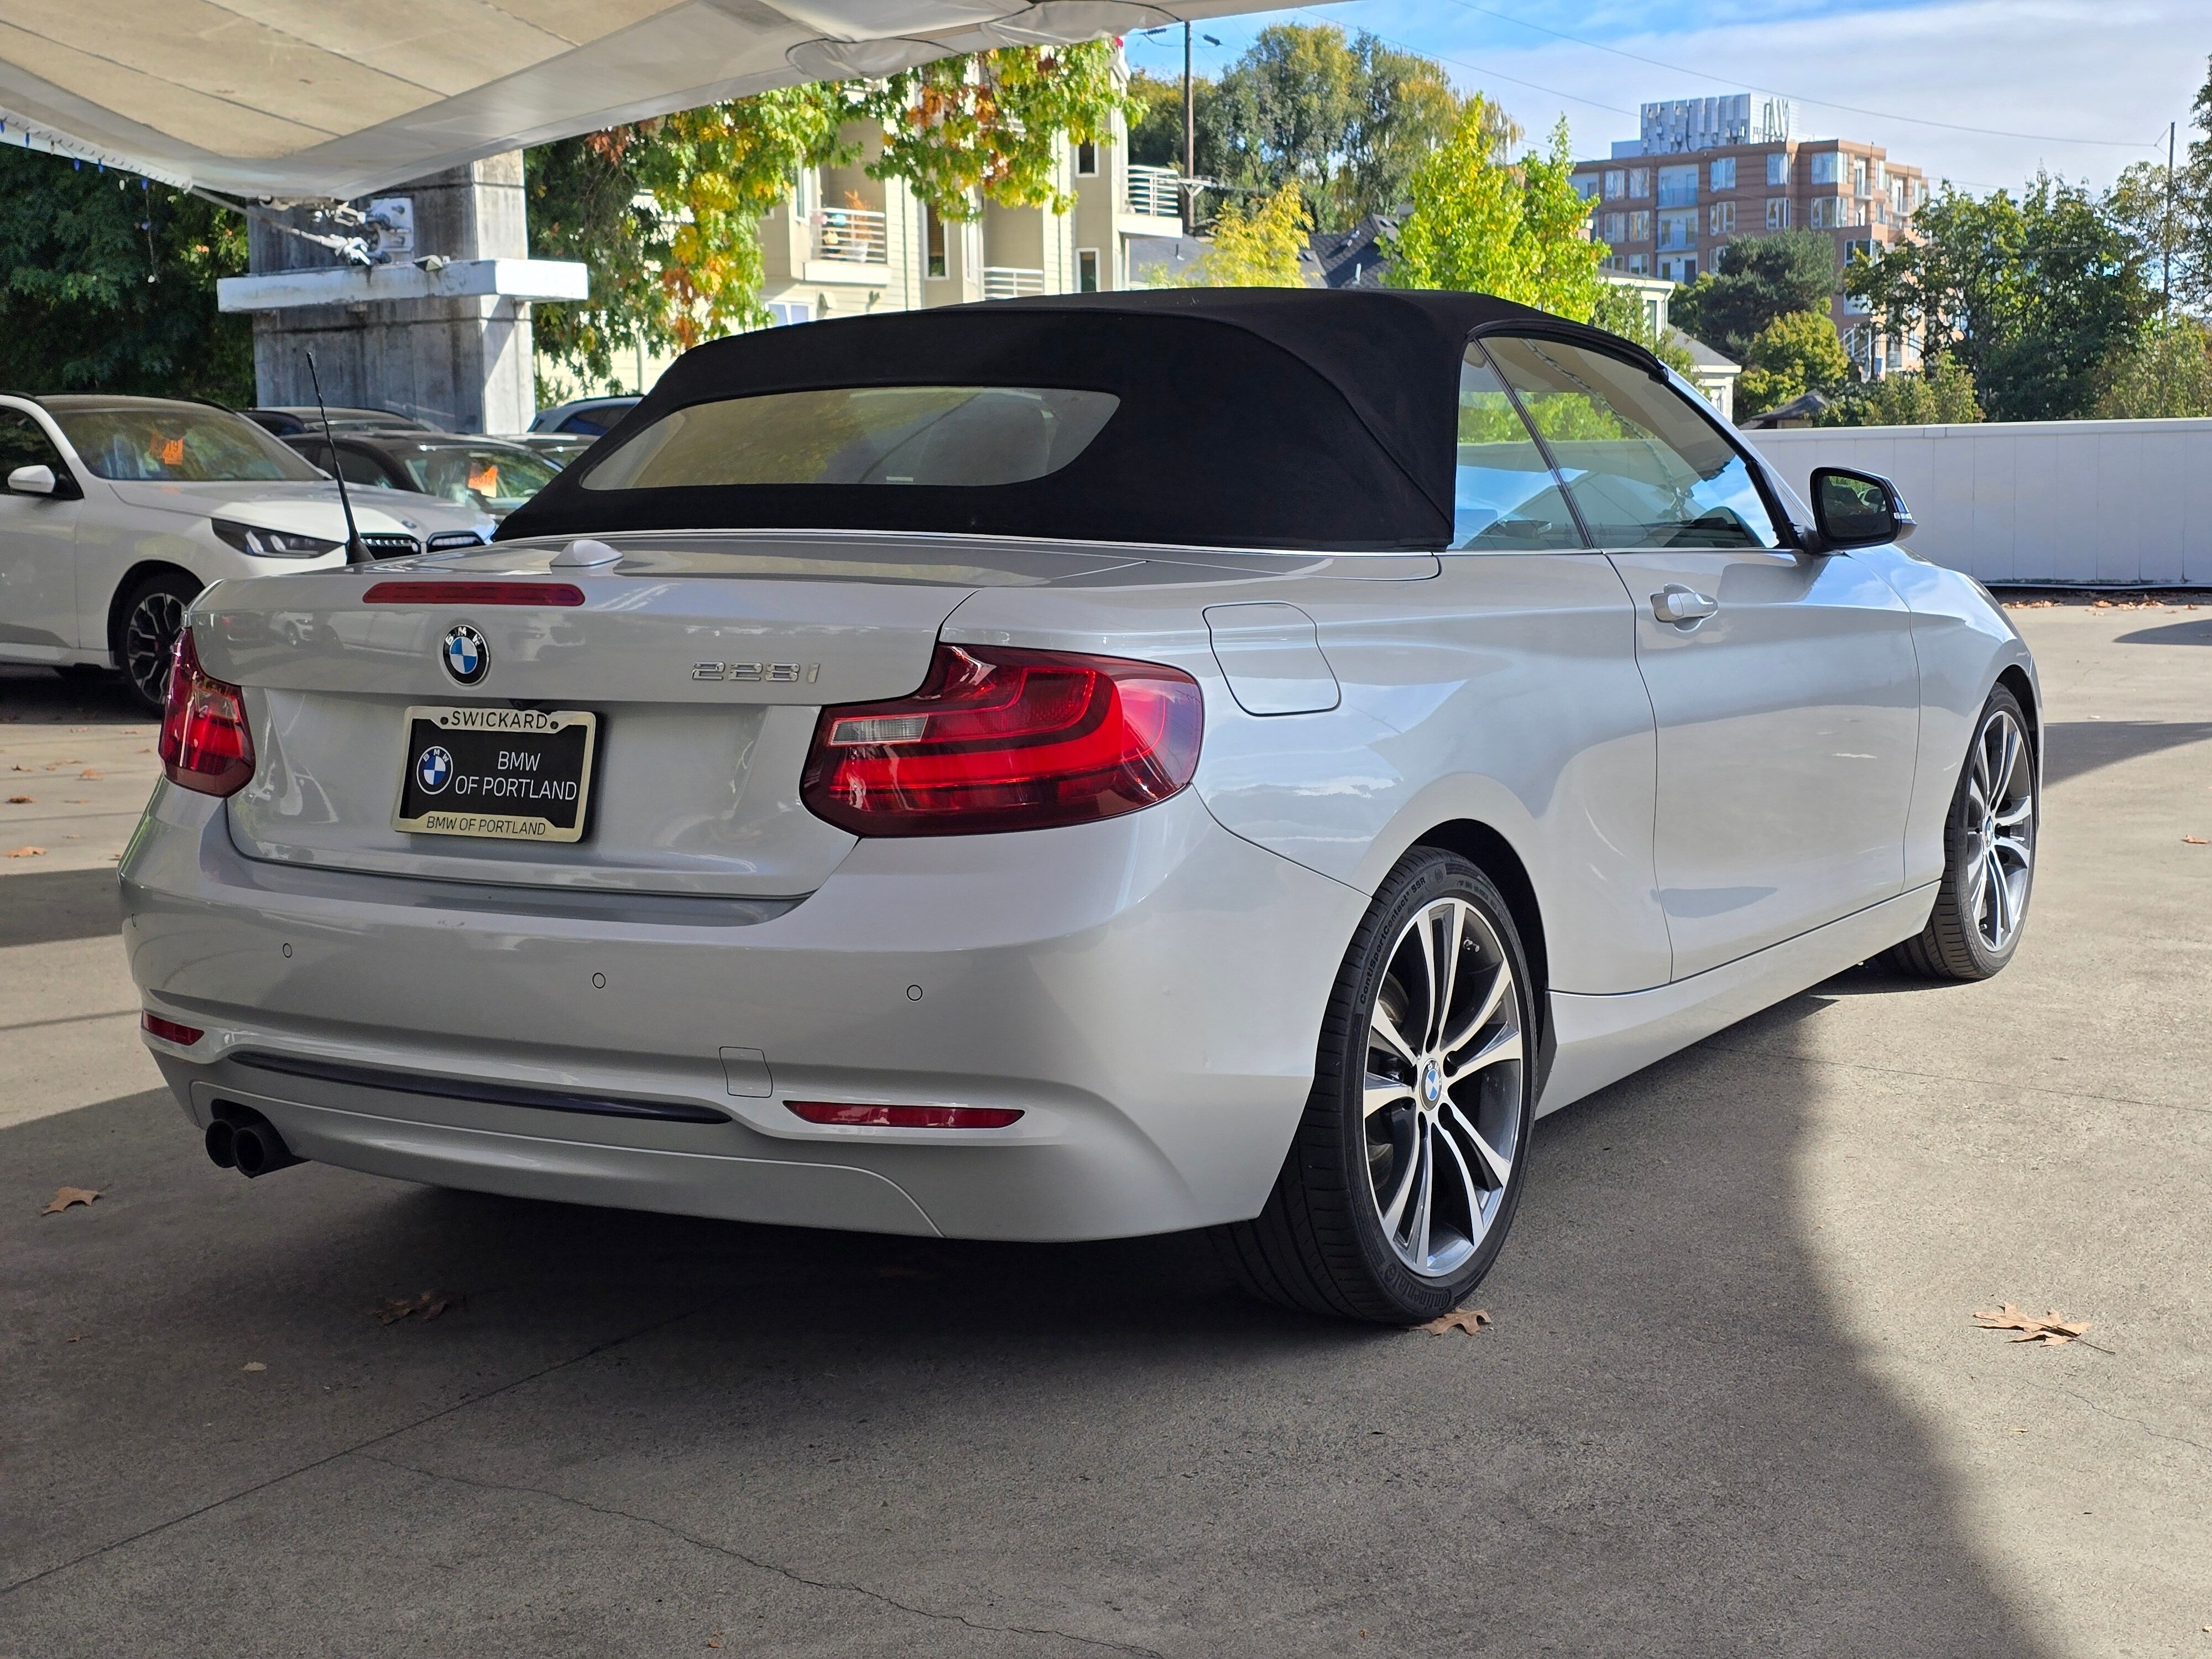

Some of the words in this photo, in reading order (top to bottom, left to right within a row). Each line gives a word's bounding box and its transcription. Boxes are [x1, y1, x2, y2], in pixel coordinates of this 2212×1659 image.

[445, 627, 482, 646] BMW
[451, 711, 547, 729] SWICKARD
[422, 749, 450, 762] BMW
[498, 751, 541, 771] BMW
[455, 775, 479, 795] OF
[483, 777, 577, 801] PORTLAND
[426, 816, 457, 830] BMW
[459, 818, 476, 831] OF
[478, 818, 546, 836] PORTLAND
